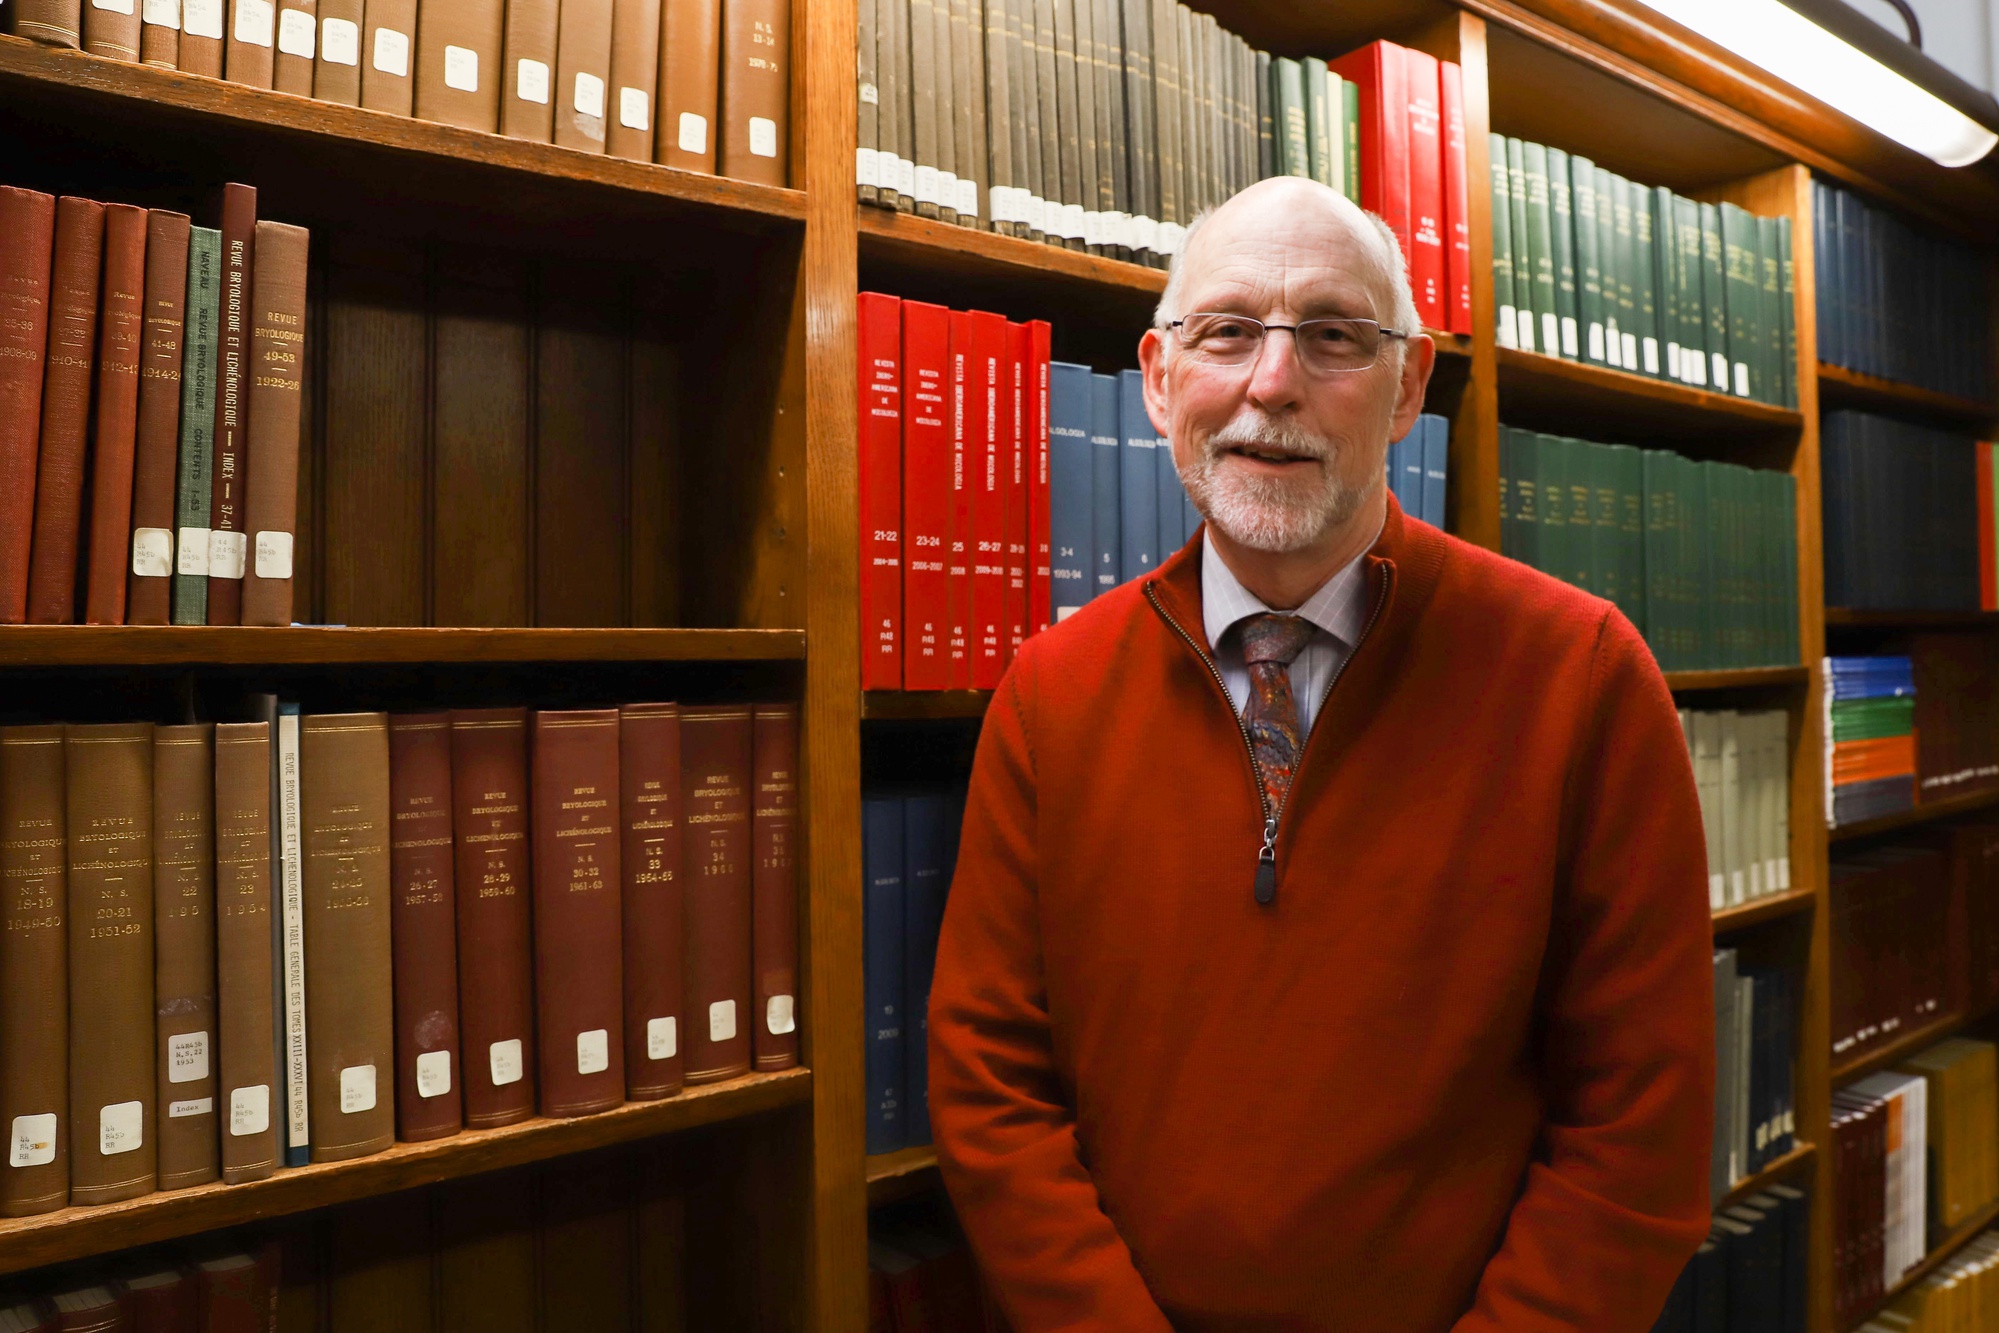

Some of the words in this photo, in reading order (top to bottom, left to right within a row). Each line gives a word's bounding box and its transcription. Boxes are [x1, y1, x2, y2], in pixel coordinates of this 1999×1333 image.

[230, 239, 244, 267] REVUE
[200, 251, 210, 289] NAVEAU
[113, 291, 135, 300] Revue
[227, 271, 242, 333] BRYOLOGIQUE
[197, 307, 208, 340] REVUE
[267, 311, 298, 325] REVUE
[255, 327, 304, 342] BRYOLOGIQUE
[227, 336, 240, 348] ET
[52, 356, 87, 368] 910-11
[263, 351, 296, 363] 49-53
[194, 344, 208, 411] BRYOLOGIQUE
[256, 376, 300, 390] 1922-26
[224, 351, 242, 428] LICHÉNOLOGIQUE
[191, 428, 203, 481] CONTENTS
[221, 452, 235, 480] INDEX
[220, 504, 233, 530] 37-41
[874, 530, 897, 542] 21-22
[916, 535, 940, 547] 23-24
[952, 541, 964, 553] 25
[978, 541, 1002, 552] 26-27
[1060, 547, 1074, 557] 3-4
[285, 752, 295, 776] REVUE
[706, 775, 730, 784] REVUE
[484, 792, 507, 800] REVUE
[574, 787, 596, 795] REVUE
[285, 779, 296, 830] BRYOLOGIQUE
[472, 804, 519, 815] BRYOLOGIQUE
[562, 799, 607, 809] BRYOLOGIQUE
[714, 801, 723, 810] ET
[19, 819, 53, 828] REVUE
[92, 817, 134, 827] REVUE
[2, 838, 63, 848] RYOLOGIQU
[286, 833, 297, 843] ET
[72, 858, 148, 870] LICHÉNOLOGIQU
[648, 859, 661, 870] 33
[2, 866, 63, 877] ICHÉNOLOGIQU
[573, 867, 600, 878] 30-32
[287, 847, 299, 912] LICHENOLOGIQUE
[483, 873, 511, 884] 28-29
[38, 886, 47, 894] S.
[240, 884, 254, 895] 23
[410, 879, 438, 891] 26-27
[120, 889, 129, 897] S.
[182, 886, 197, 897] 22
[479, 885, 516, 898] 1959-60
[17, 897, 54, 910] 18-19
[97, 906, 132, 919] 20-21
[7, 916, 61, 930] 1949-50
[90, 923, 141, 938] 1951-52
[289, 924, 300, 947] TABLE
[290, 951, 300, 988] GENERALE
[291, 992, 301, 1006] DES
[291, 1010, 301, 1033] TOMES
[176, 1058, 194, 1066] 1953
[293, 1086, 304, 1097] 44
[176, 1105, 199, 1113] Index
[293, 1121, 304, 1133] RR
